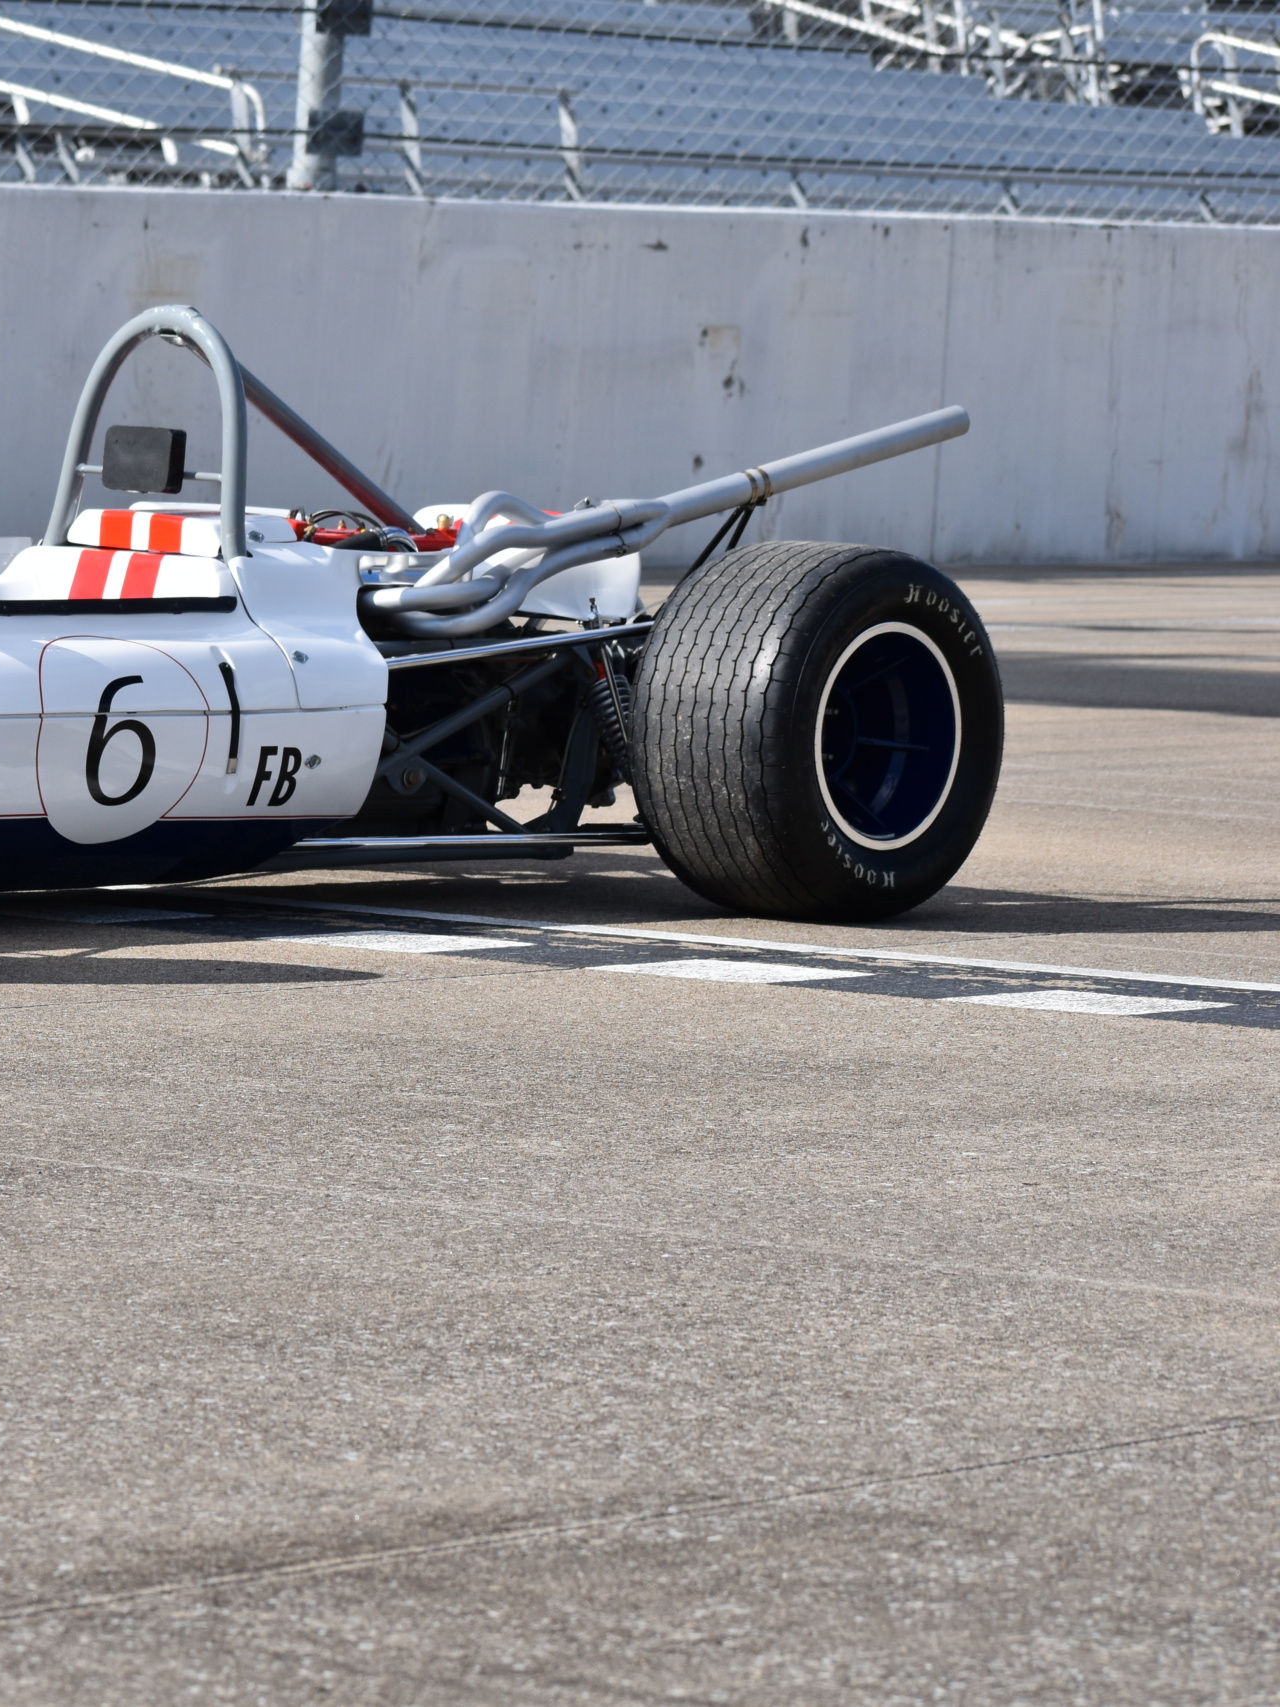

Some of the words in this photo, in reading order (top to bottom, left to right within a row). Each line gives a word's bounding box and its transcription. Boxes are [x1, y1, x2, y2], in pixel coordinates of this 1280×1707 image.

[903, 583, 983, 657] Hoosier
[86, 675, 156, 806] 6
[246, 746, 302, 806] FB
[820, 820, 896, 888] Hoosier
